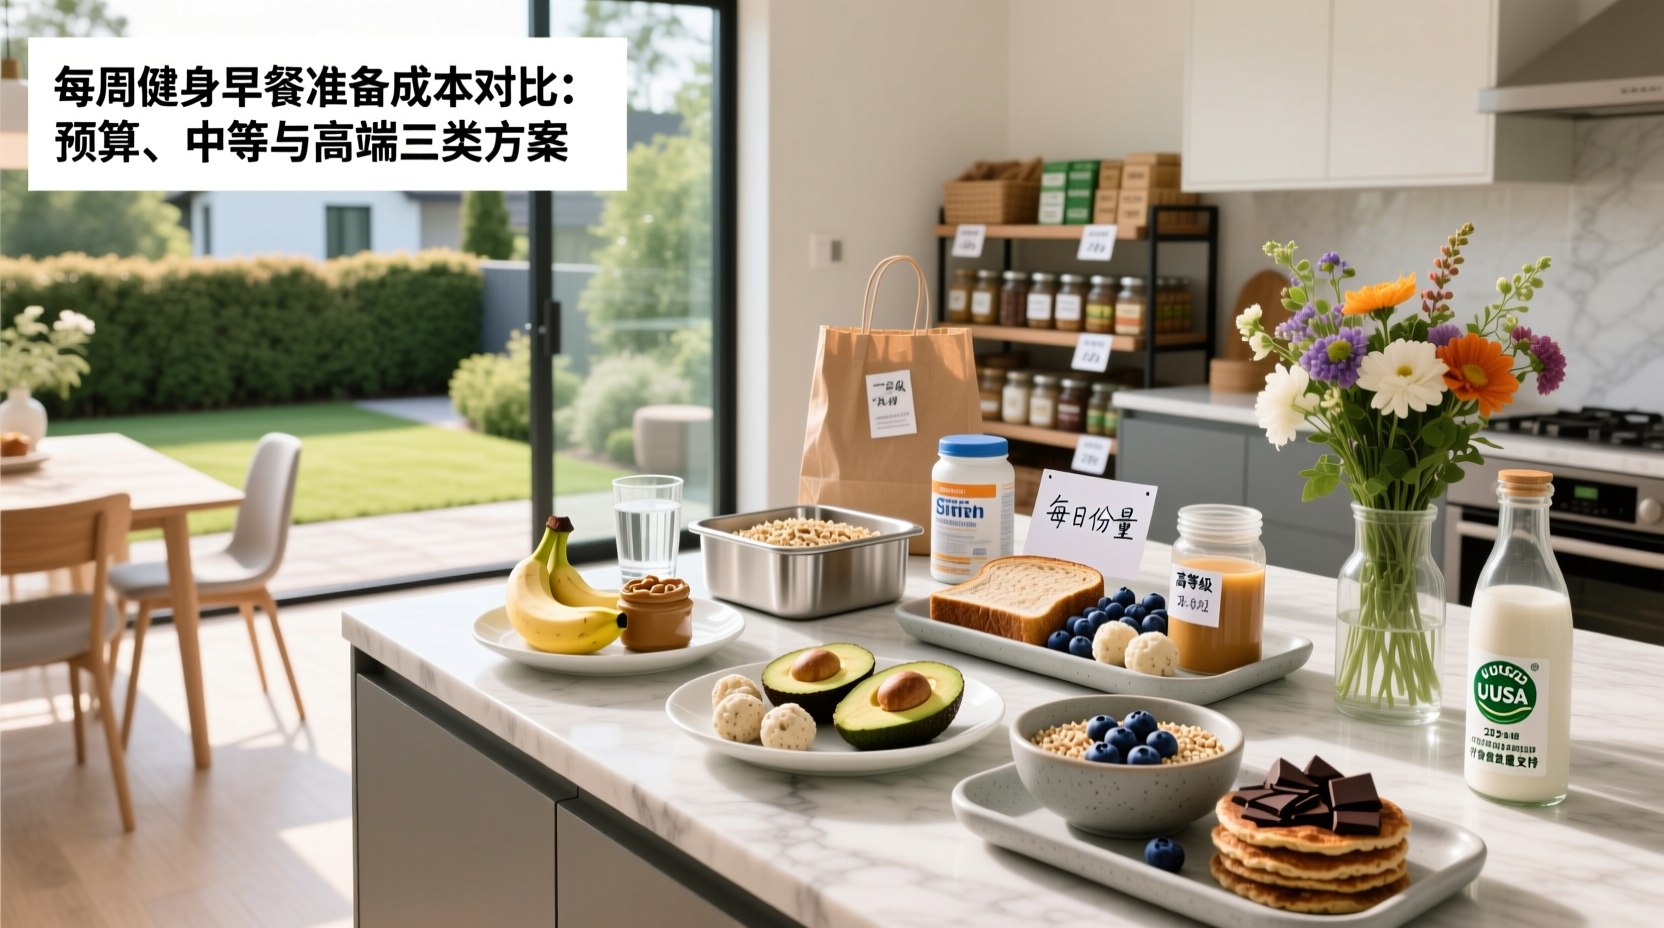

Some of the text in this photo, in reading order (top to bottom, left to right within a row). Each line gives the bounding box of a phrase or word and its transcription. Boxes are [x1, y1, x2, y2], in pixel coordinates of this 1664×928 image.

[1046, 494, 1138, 541] 每日份量
[1176, 572, 1213, 594] 高等级
[1477, 682, 1528, 705] UUSA
